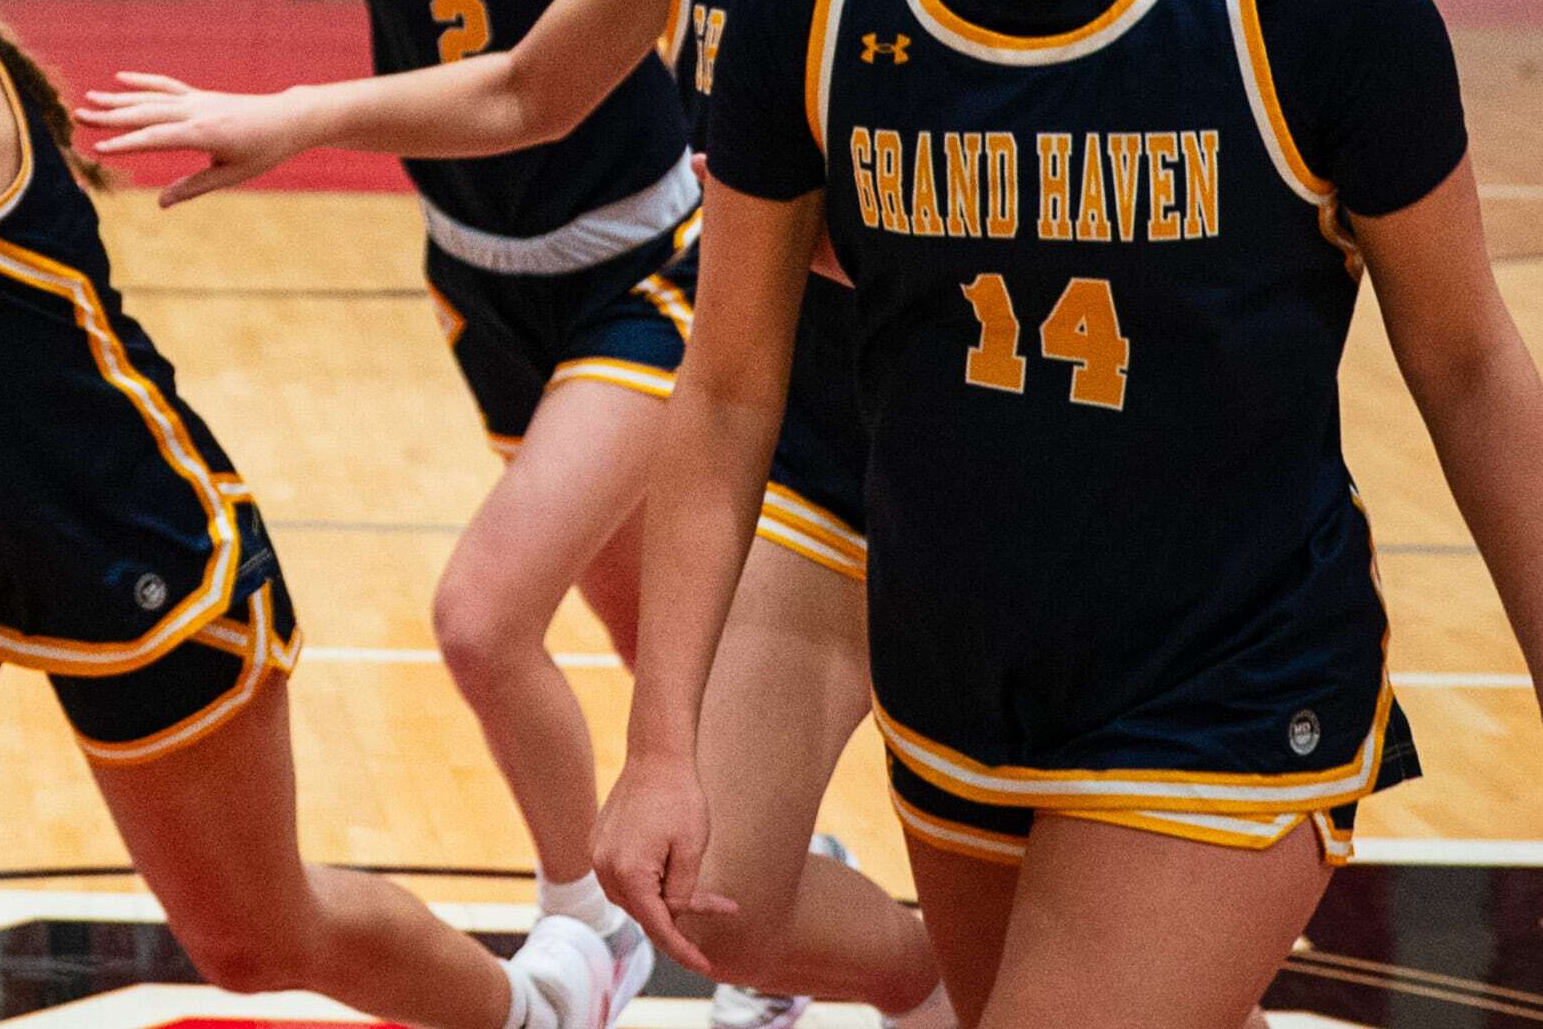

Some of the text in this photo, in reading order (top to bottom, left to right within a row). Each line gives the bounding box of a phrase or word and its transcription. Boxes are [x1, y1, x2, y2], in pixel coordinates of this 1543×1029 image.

[850, 126, 1220, 242] GRAND HAVEN
[960, 273, 1130, 412] 14
